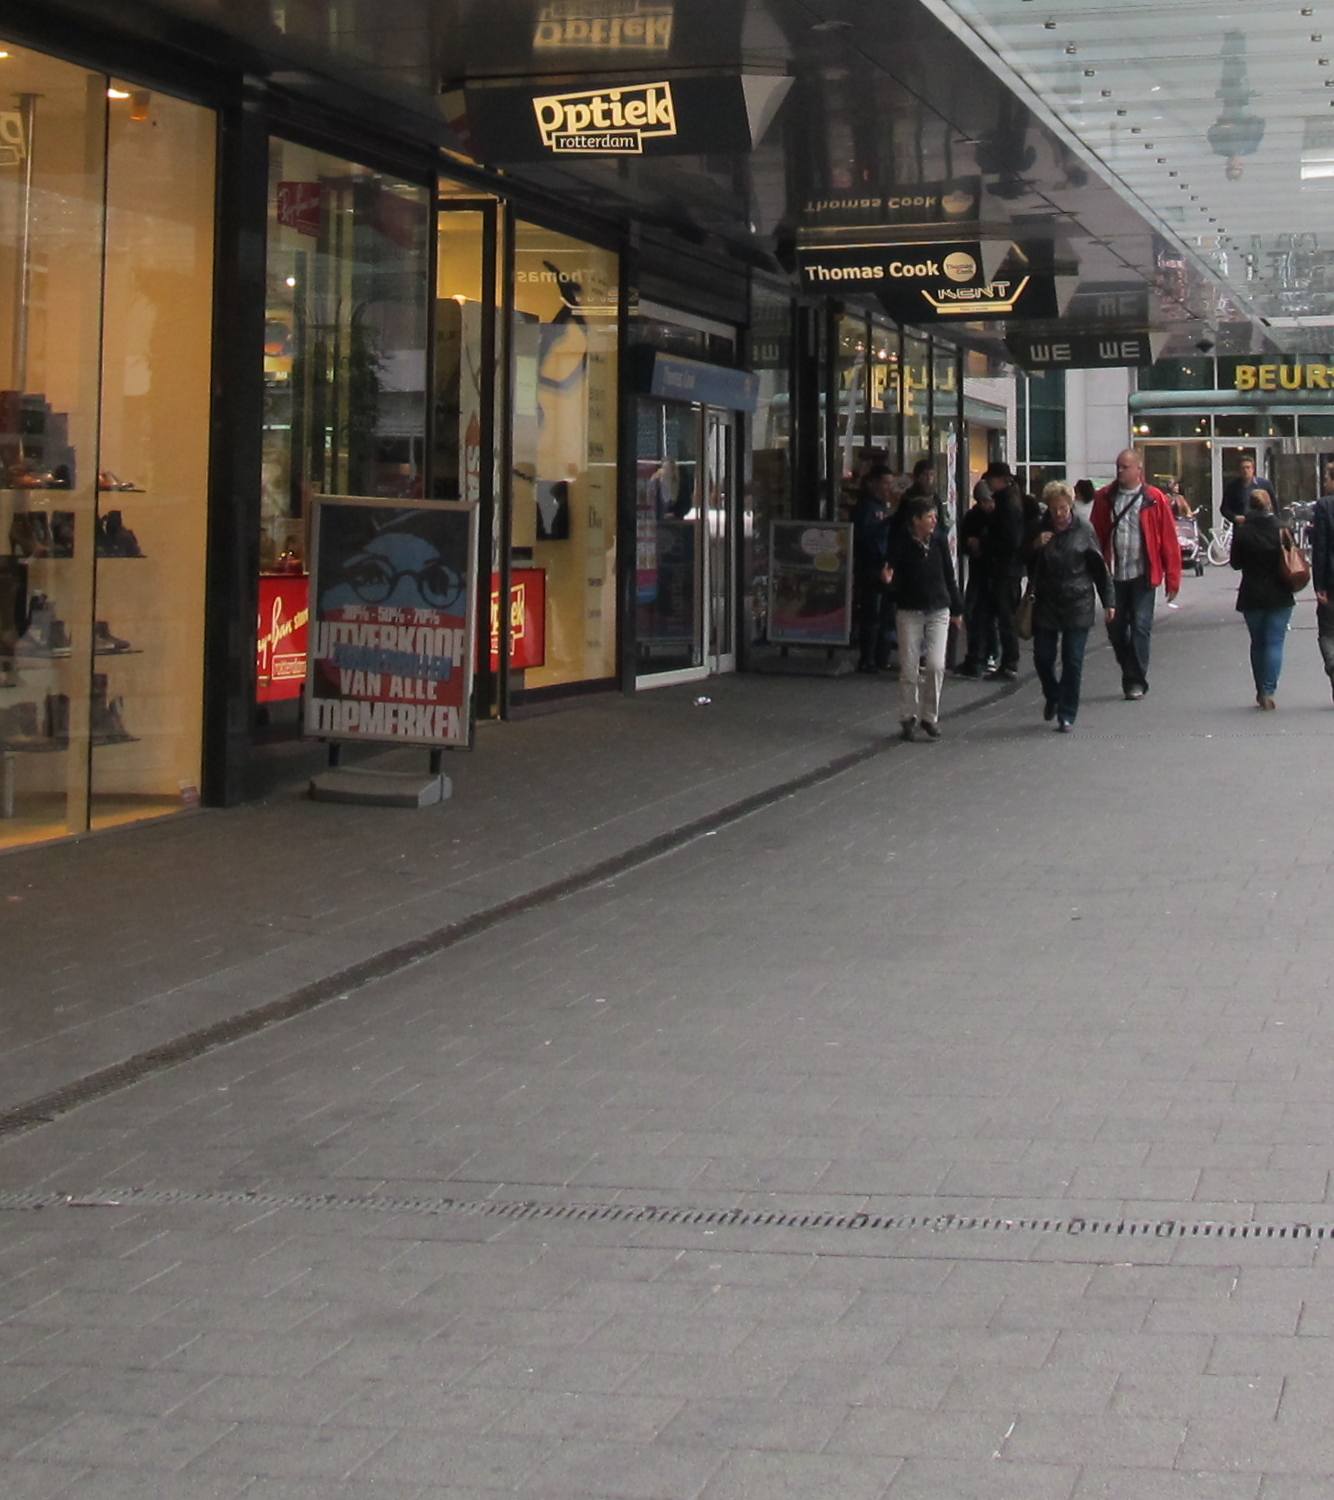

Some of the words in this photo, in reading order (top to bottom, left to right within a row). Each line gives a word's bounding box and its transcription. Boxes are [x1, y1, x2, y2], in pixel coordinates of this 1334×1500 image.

[536, 88, 671, 133] Optiek
[559, 133, 636, 149] rotterdam
[805, 263, 884, 282] Thomas
[889, 260, 940, 279] Cook
[937, 280, 1011, 300] KENT
[1030, 344, 1071, 361] WE
[1098, 341, 1140, 359] WE
[340, 668, 382, 697] VAN
[388, 675, 438, 701] ALLE
